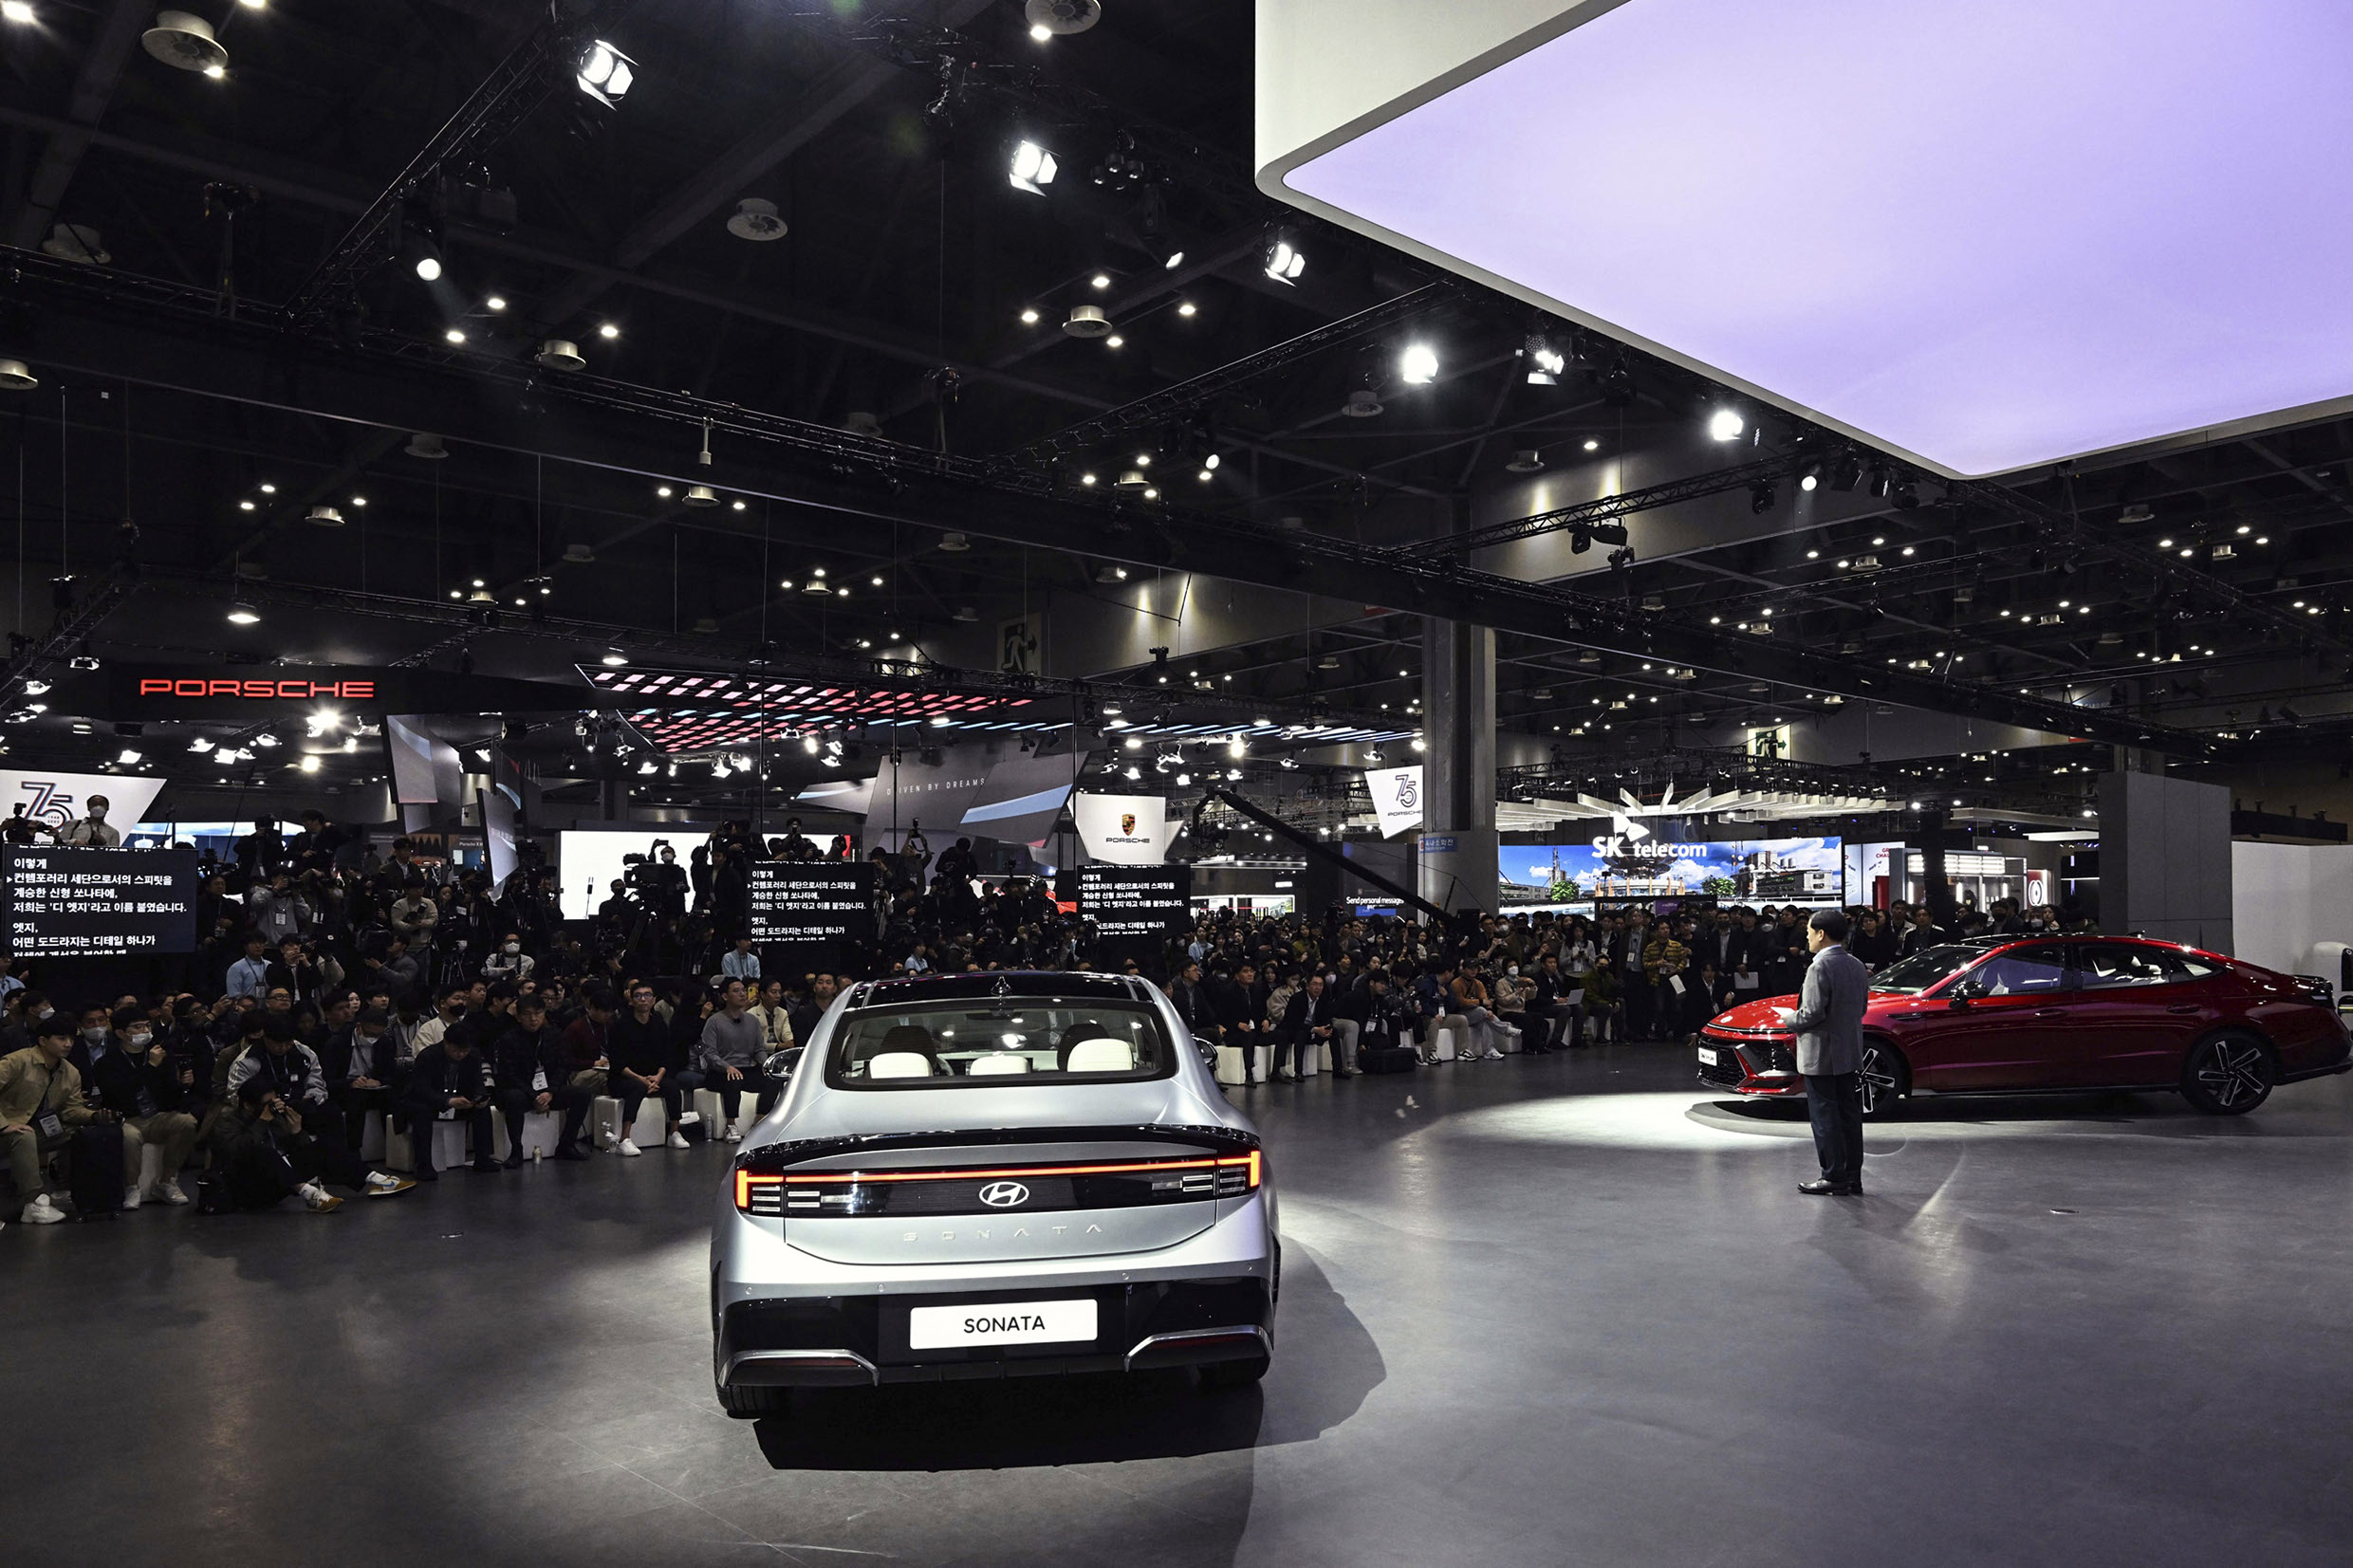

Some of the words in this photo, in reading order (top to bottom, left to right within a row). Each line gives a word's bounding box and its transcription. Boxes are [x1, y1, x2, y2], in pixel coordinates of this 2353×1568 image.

[140, 678, 375, 698] PORSCHE
[886, 785, 920, 796] DIVEN
[928, 783, 939, 791] BY
[946, 778, 985, 789] DREAMS
[1395, 774, 1417, 808] 75
[21, 781, 74, 830] 75
[1592, 836, 1624, 858] SK
[1632, 839, 1707, 858] telecom
[14, 858, 46, 869] 이렇게
[14, 873, 66, 883] 컨템포러리
[71, 874, 131, 884] 세단으로서의
[134, 876, 172, 885] 스피릿을
[14, 888, 46, 898] 계승한
[50, 888, 70, 898] 신형
[74, 889, 118, 898] 쏘나타에,
[1361, 896, 1381, 905] personal
[13, 902, 46, 913] 저희는
[50, 902, 63, 913] '디
[66, 902, 111, 913] 엣지'라고
[114, 902, 134, 913] 이름
[137, 903, 186, 913] 붙였습니다.
[13, 923, 38, 933] 엣지,
[13, 937, 34, 948] 어떤
[38, 936, 90, 947] 도드라지는
[94, 936, 122, 946] 디테일
[126, 935, 155, 945] 하나가
[902, 1224, 1102, 1242] SONATA
[963, 1316, 1046, 1334] SONATA
